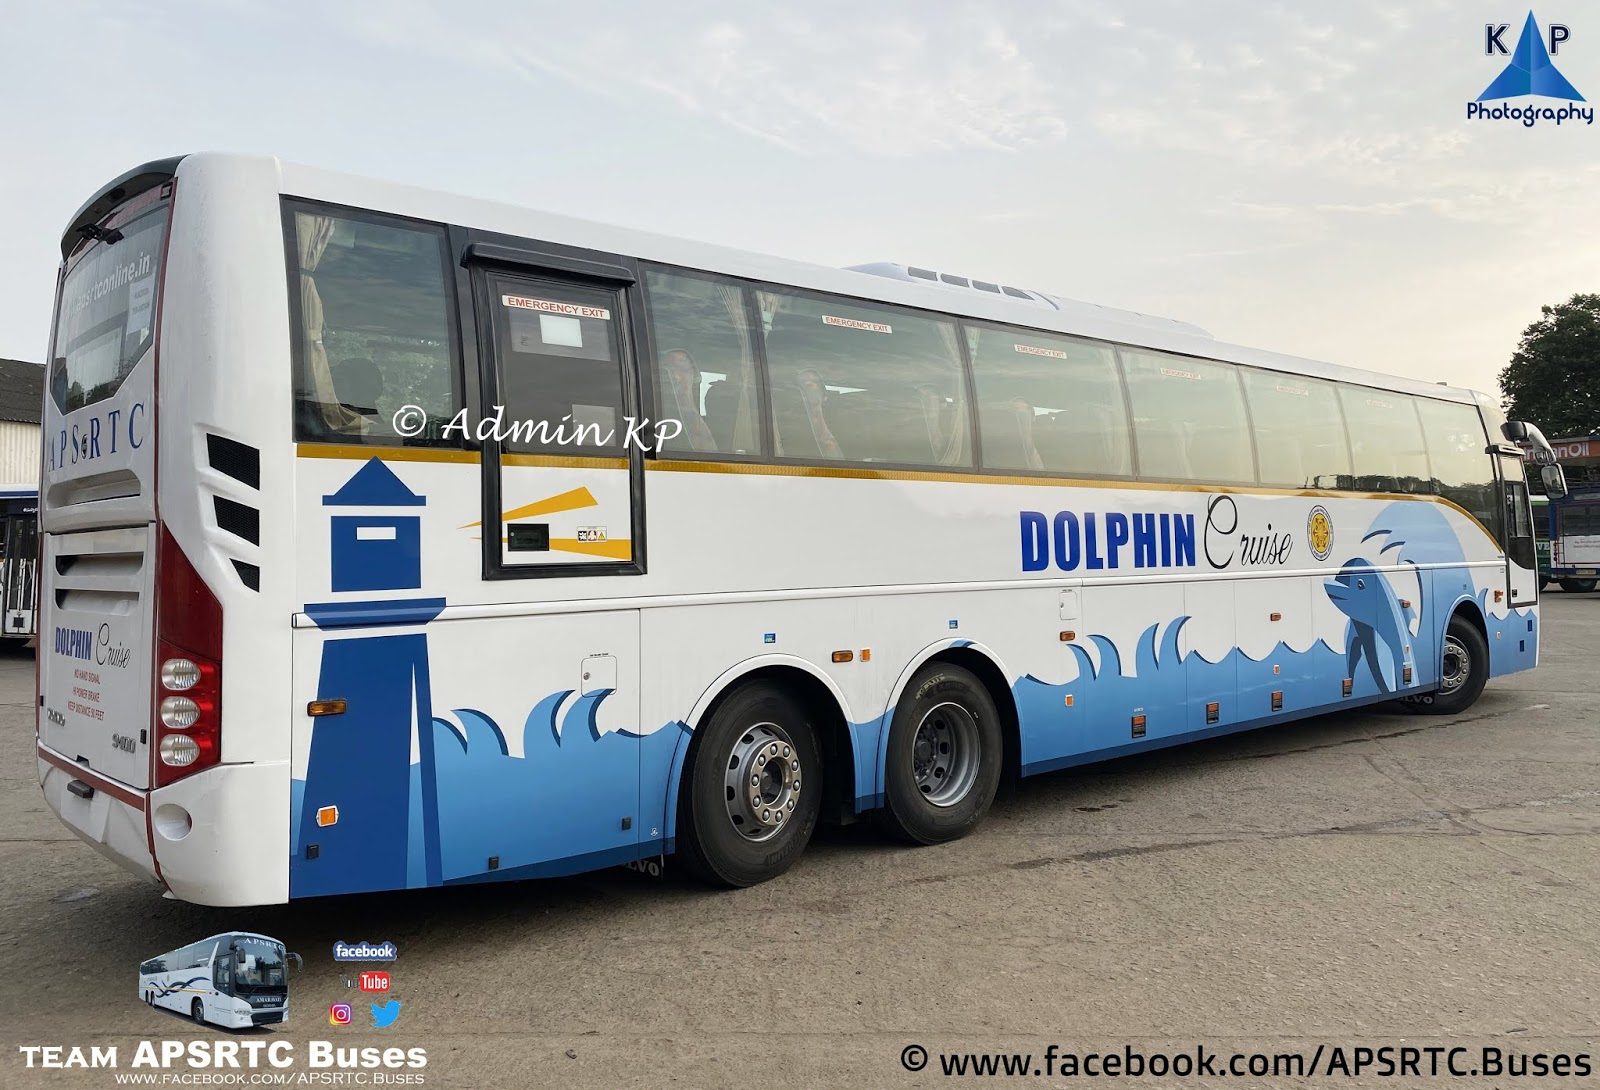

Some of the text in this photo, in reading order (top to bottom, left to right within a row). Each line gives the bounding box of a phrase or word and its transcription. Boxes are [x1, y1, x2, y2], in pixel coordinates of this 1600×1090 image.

[508, 297, 605, 318] EMERGENCY EXIT
[825, 316, 888, 332] EMERGENCY EXIT
[1017, 345, 1051, 356] EMERGENCY
[48, 401, 145, 473] APSRTC
[1020, 510, 1196, 572] DOLPHIN
[1204, 494, 1294, 570] Cruise
[55, 622, 131, 669] DOLPHIN Cruise
